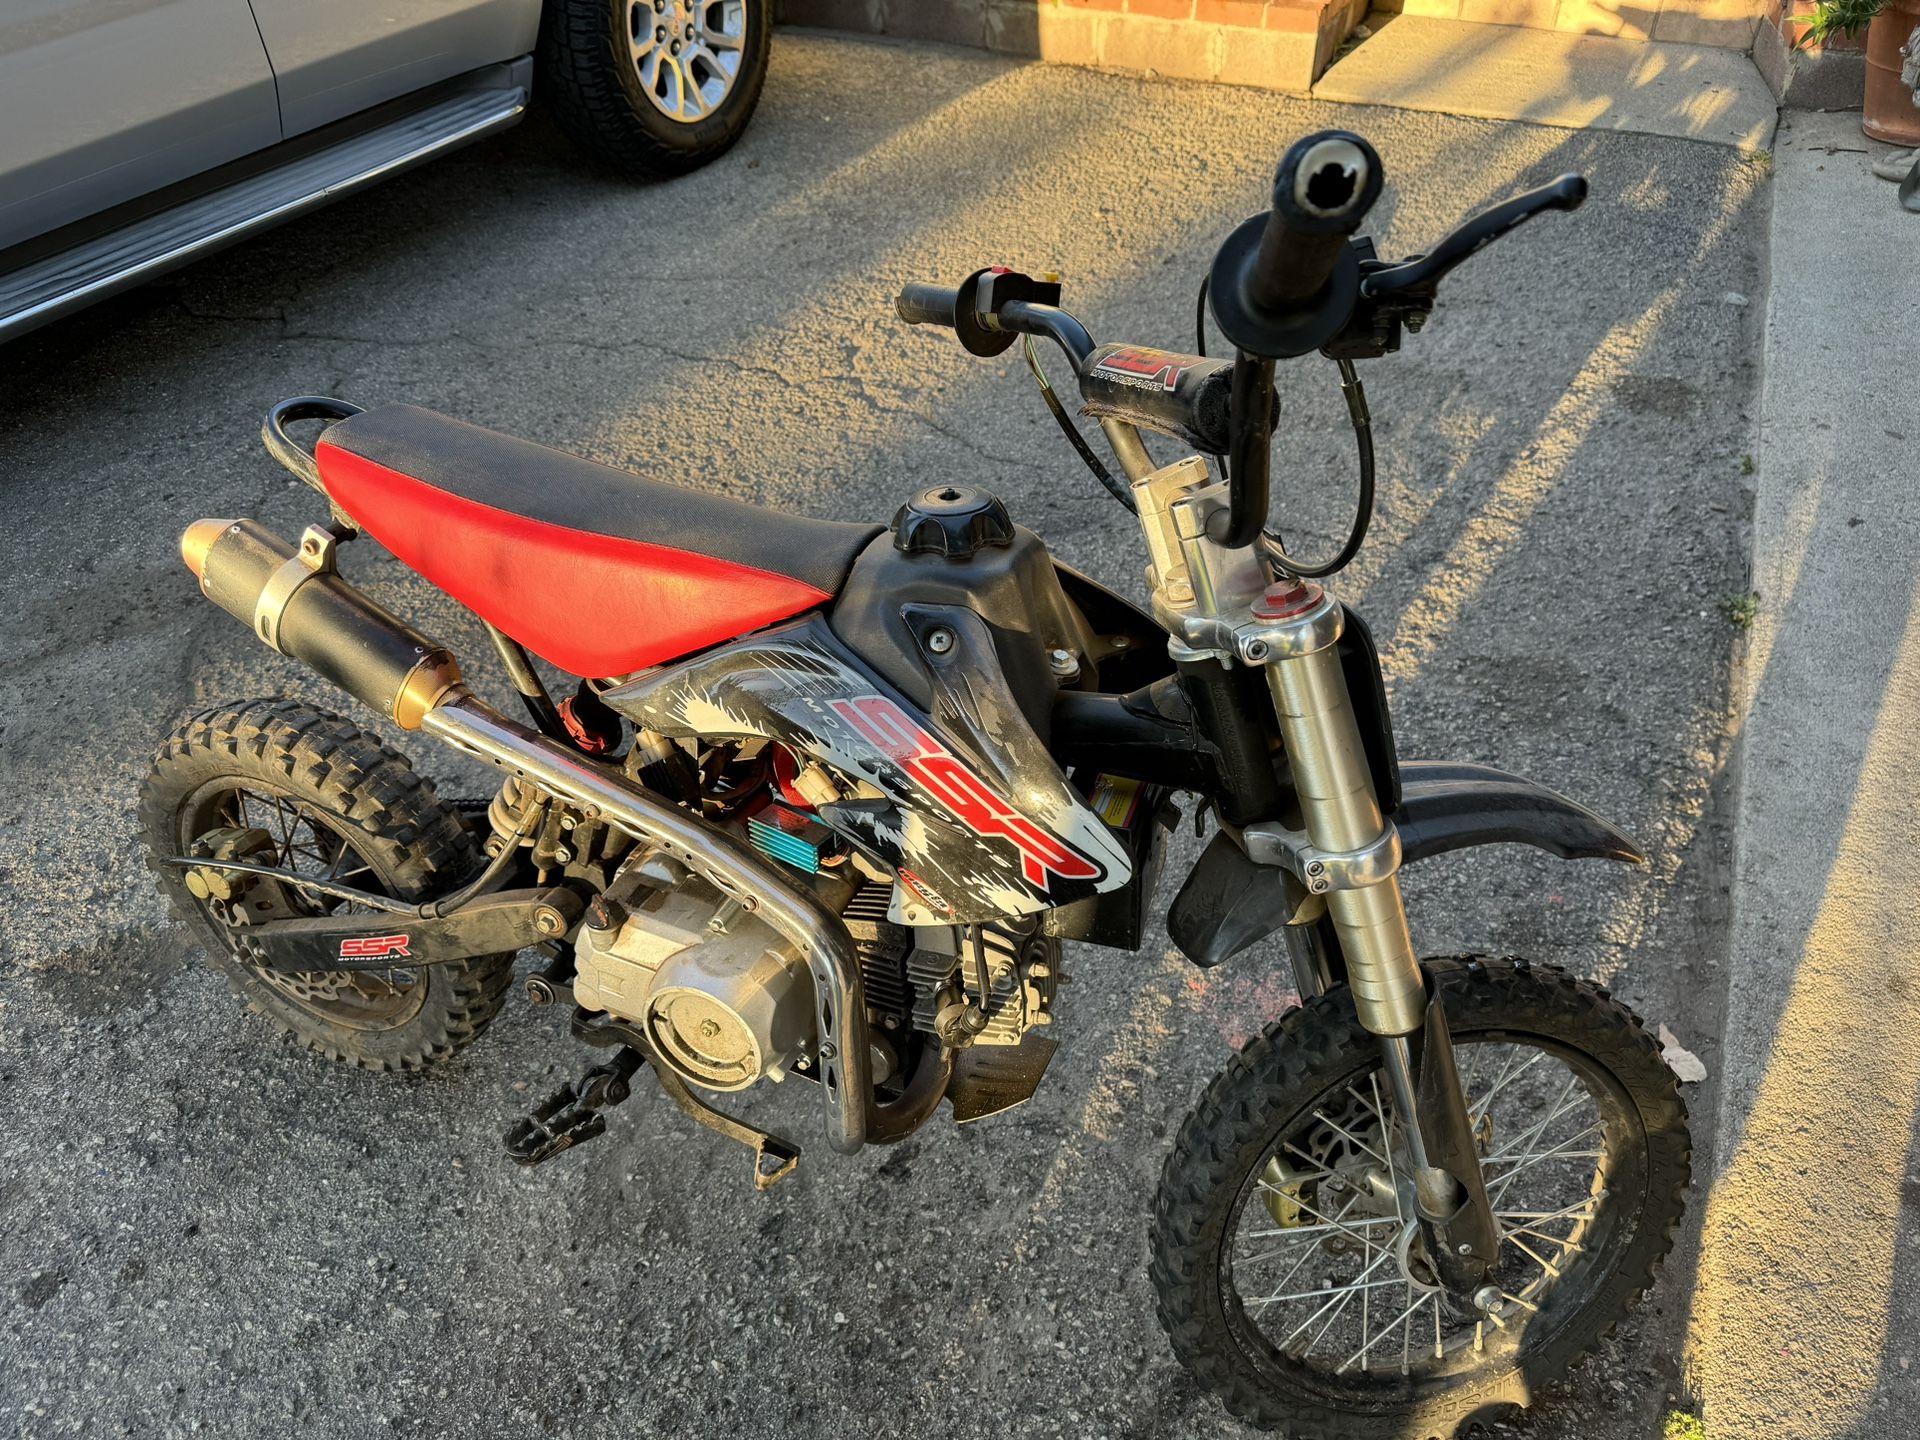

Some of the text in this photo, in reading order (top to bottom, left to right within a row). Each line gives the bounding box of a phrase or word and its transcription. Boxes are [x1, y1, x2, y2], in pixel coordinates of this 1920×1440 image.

[1090, 368, 1163, 392] MOTORSPORTS
[801, 697, 1013, 868] MOTORSPORTS
[824, 694, 1101, 894] SSR
[340, 934, 412, 956] SSR
